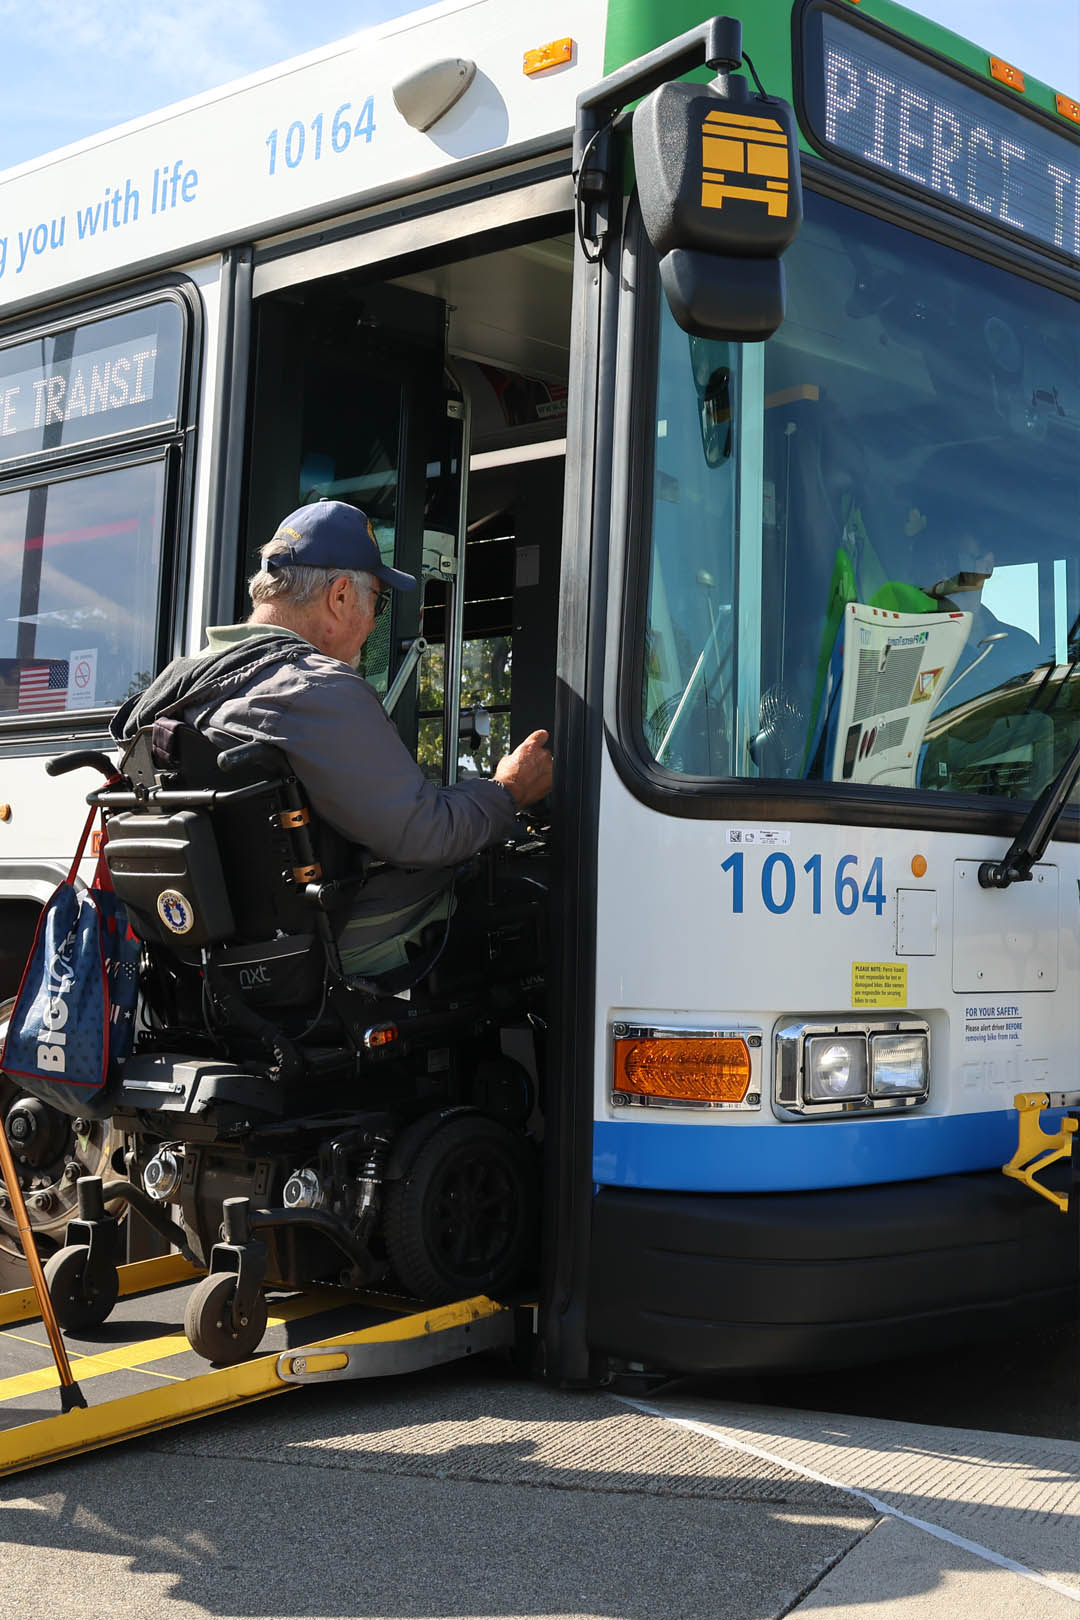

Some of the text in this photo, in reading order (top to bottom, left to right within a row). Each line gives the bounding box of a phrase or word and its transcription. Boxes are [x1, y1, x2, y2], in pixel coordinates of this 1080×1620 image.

[265, 95, 377, 176] 10164
[825, 51, 1080, 256] PIERCE T
[15, 215, 66, 274] you
[76, 178, 140, 241] with
[151, 159, 199, 215] life
[32, 348, 158, 429] TRANSI
[720, 851, 887, 916] 10164
[239, 965, 272, 984] nxt
[965, 1006, 1020, 1017] FOR YOUR SAFETY:
[965, 1024, 980, 1032] Please
[992, 1023, 1005, 1031] driver
[1005, 1022, 1023, 1031] BEFORE
[965, 1034, 987, 1043] removing
[987, 1033, 997, 1041] bike
[1009, 1032, 1020, 1040] rack.
